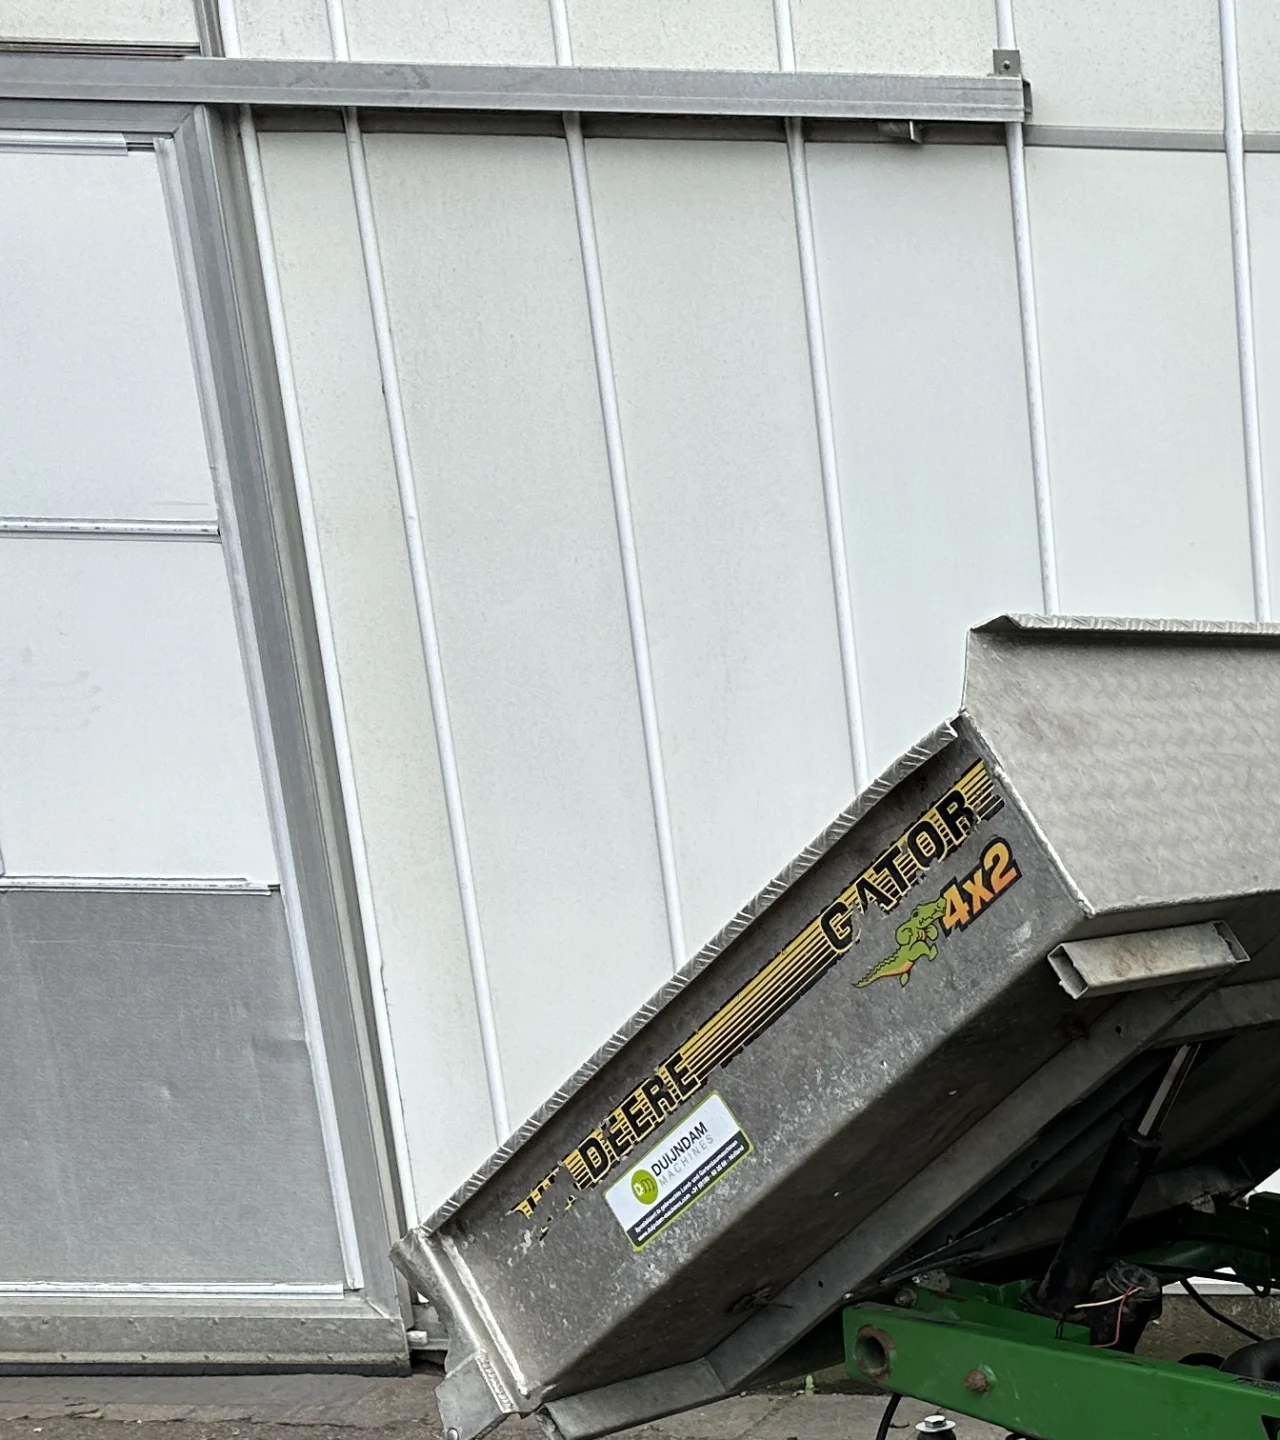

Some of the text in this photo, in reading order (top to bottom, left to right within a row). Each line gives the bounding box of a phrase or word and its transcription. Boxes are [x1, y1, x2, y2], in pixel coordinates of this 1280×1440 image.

[940, 837, 1022, 938] 4x2
[578, 788, 978, 1184] DEERE GATOR
[651, 1121, 708, 1177] DUIJNDAM
[658, 1134, 714, 1187] MACHINES
